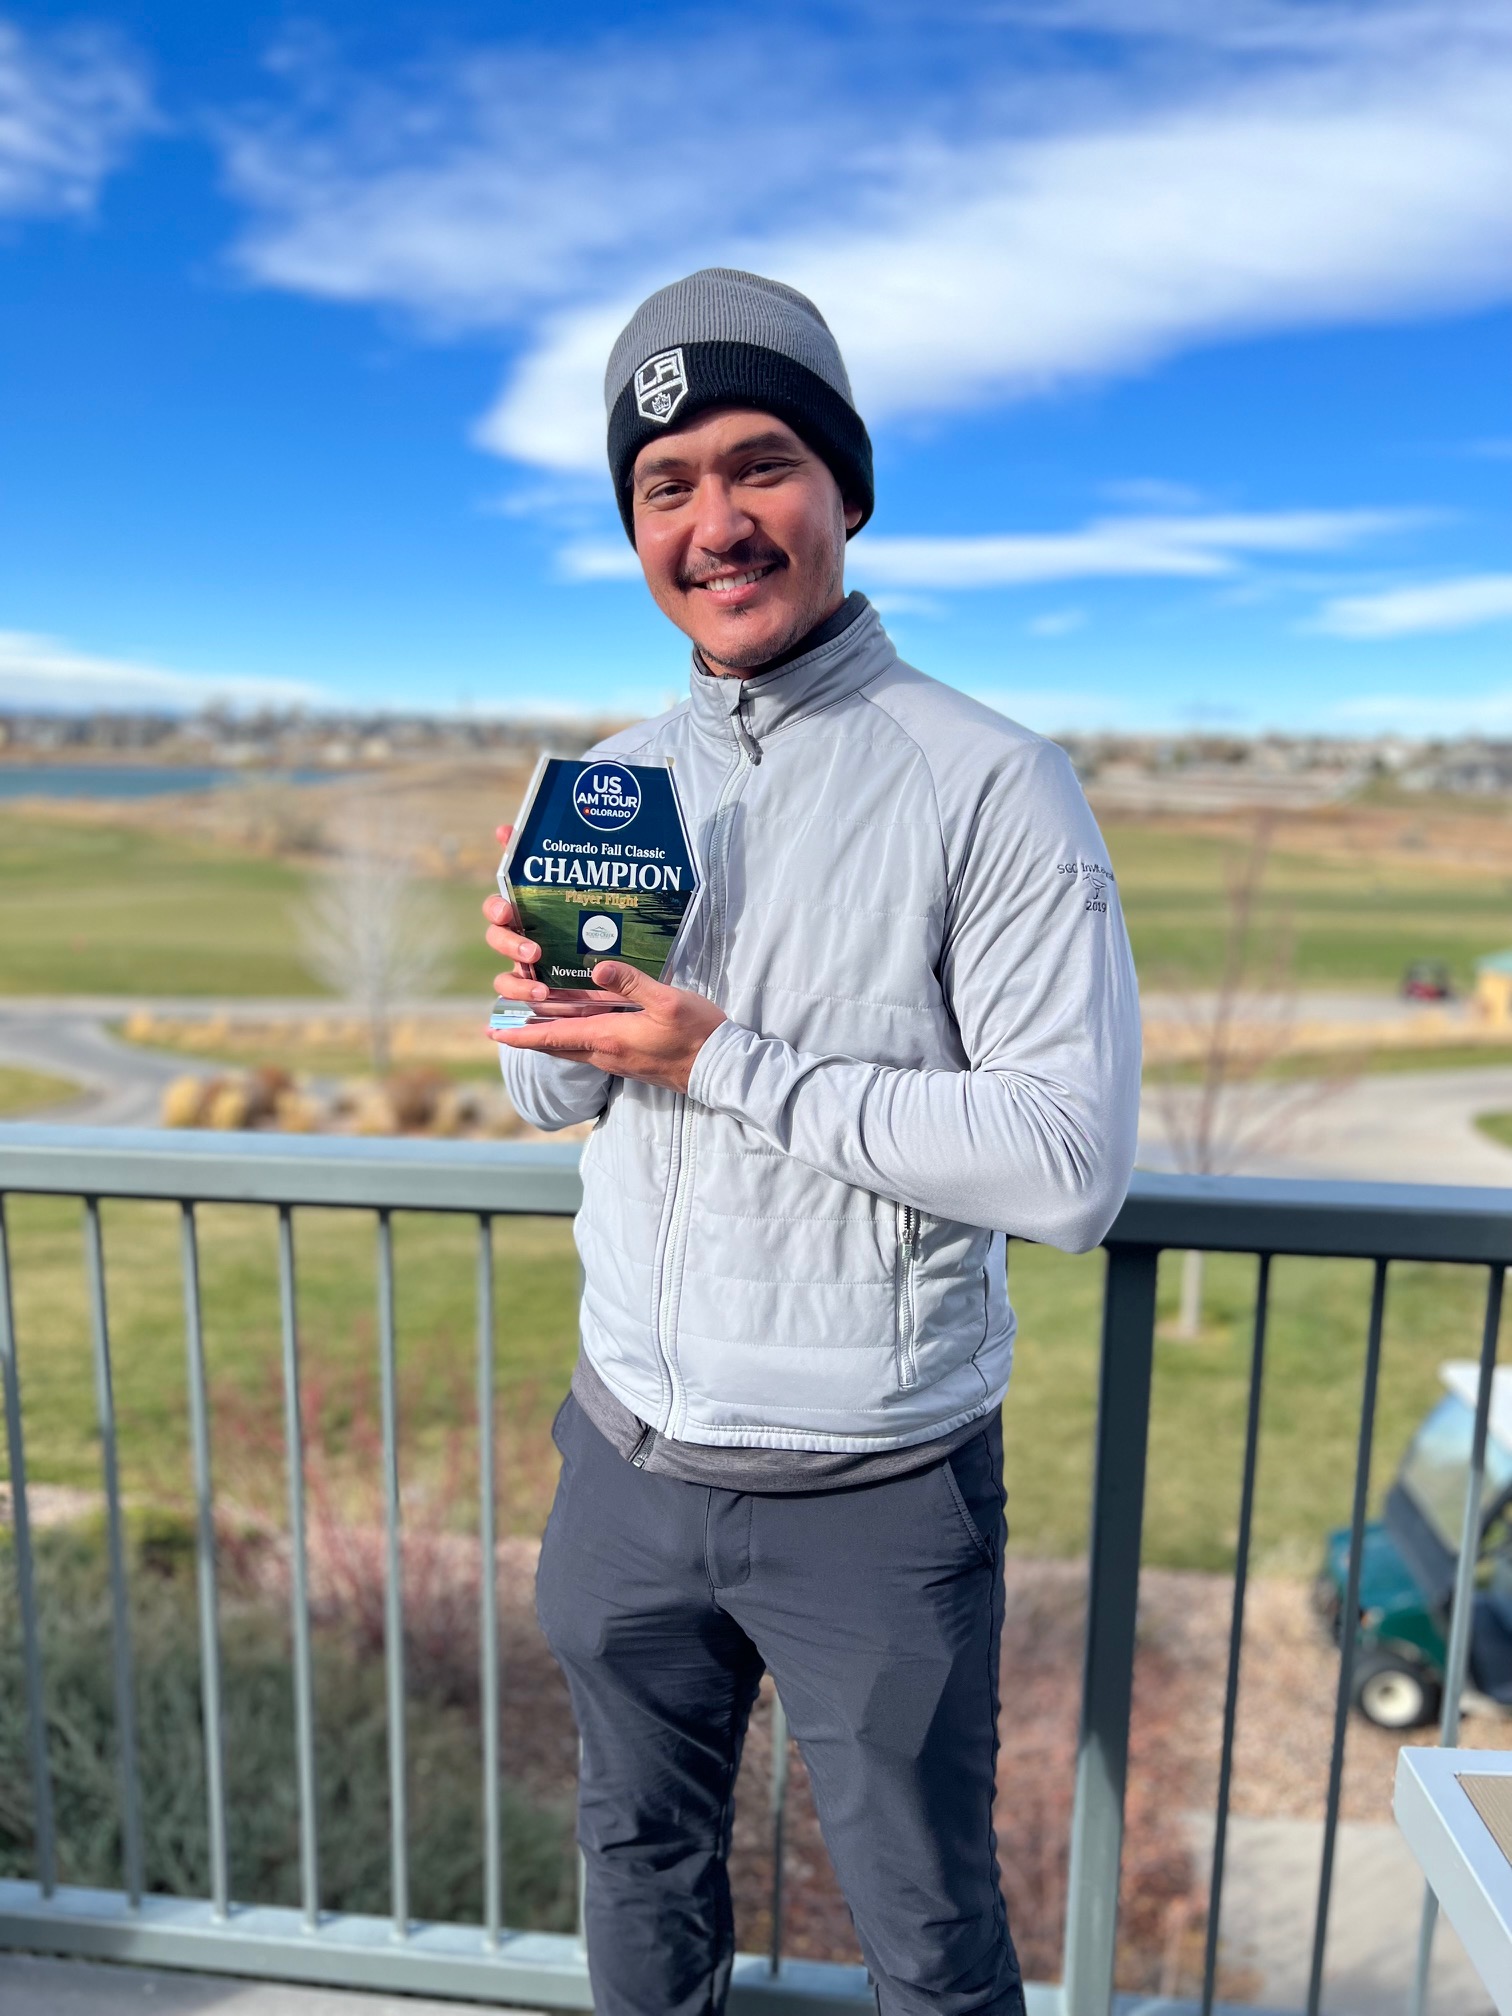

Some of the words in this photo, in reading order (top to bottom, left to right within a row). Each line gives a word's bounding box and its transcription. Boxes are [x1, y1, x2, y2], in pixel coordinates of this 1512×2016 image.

[576, 792, 599, 806] AM
[600, 793, 638, 808] TOUR
[542, 838, 598, 855] Colorado
[601, 842, 622, 856] Fall
[624, 844, 666, 859] Classic
[523, 855, 682, 892] CHAMPION
[564, 890, 602, 907] Player
[604, 892, 639, 909] Flight
[1085, 900, 1107, 913] 2019
